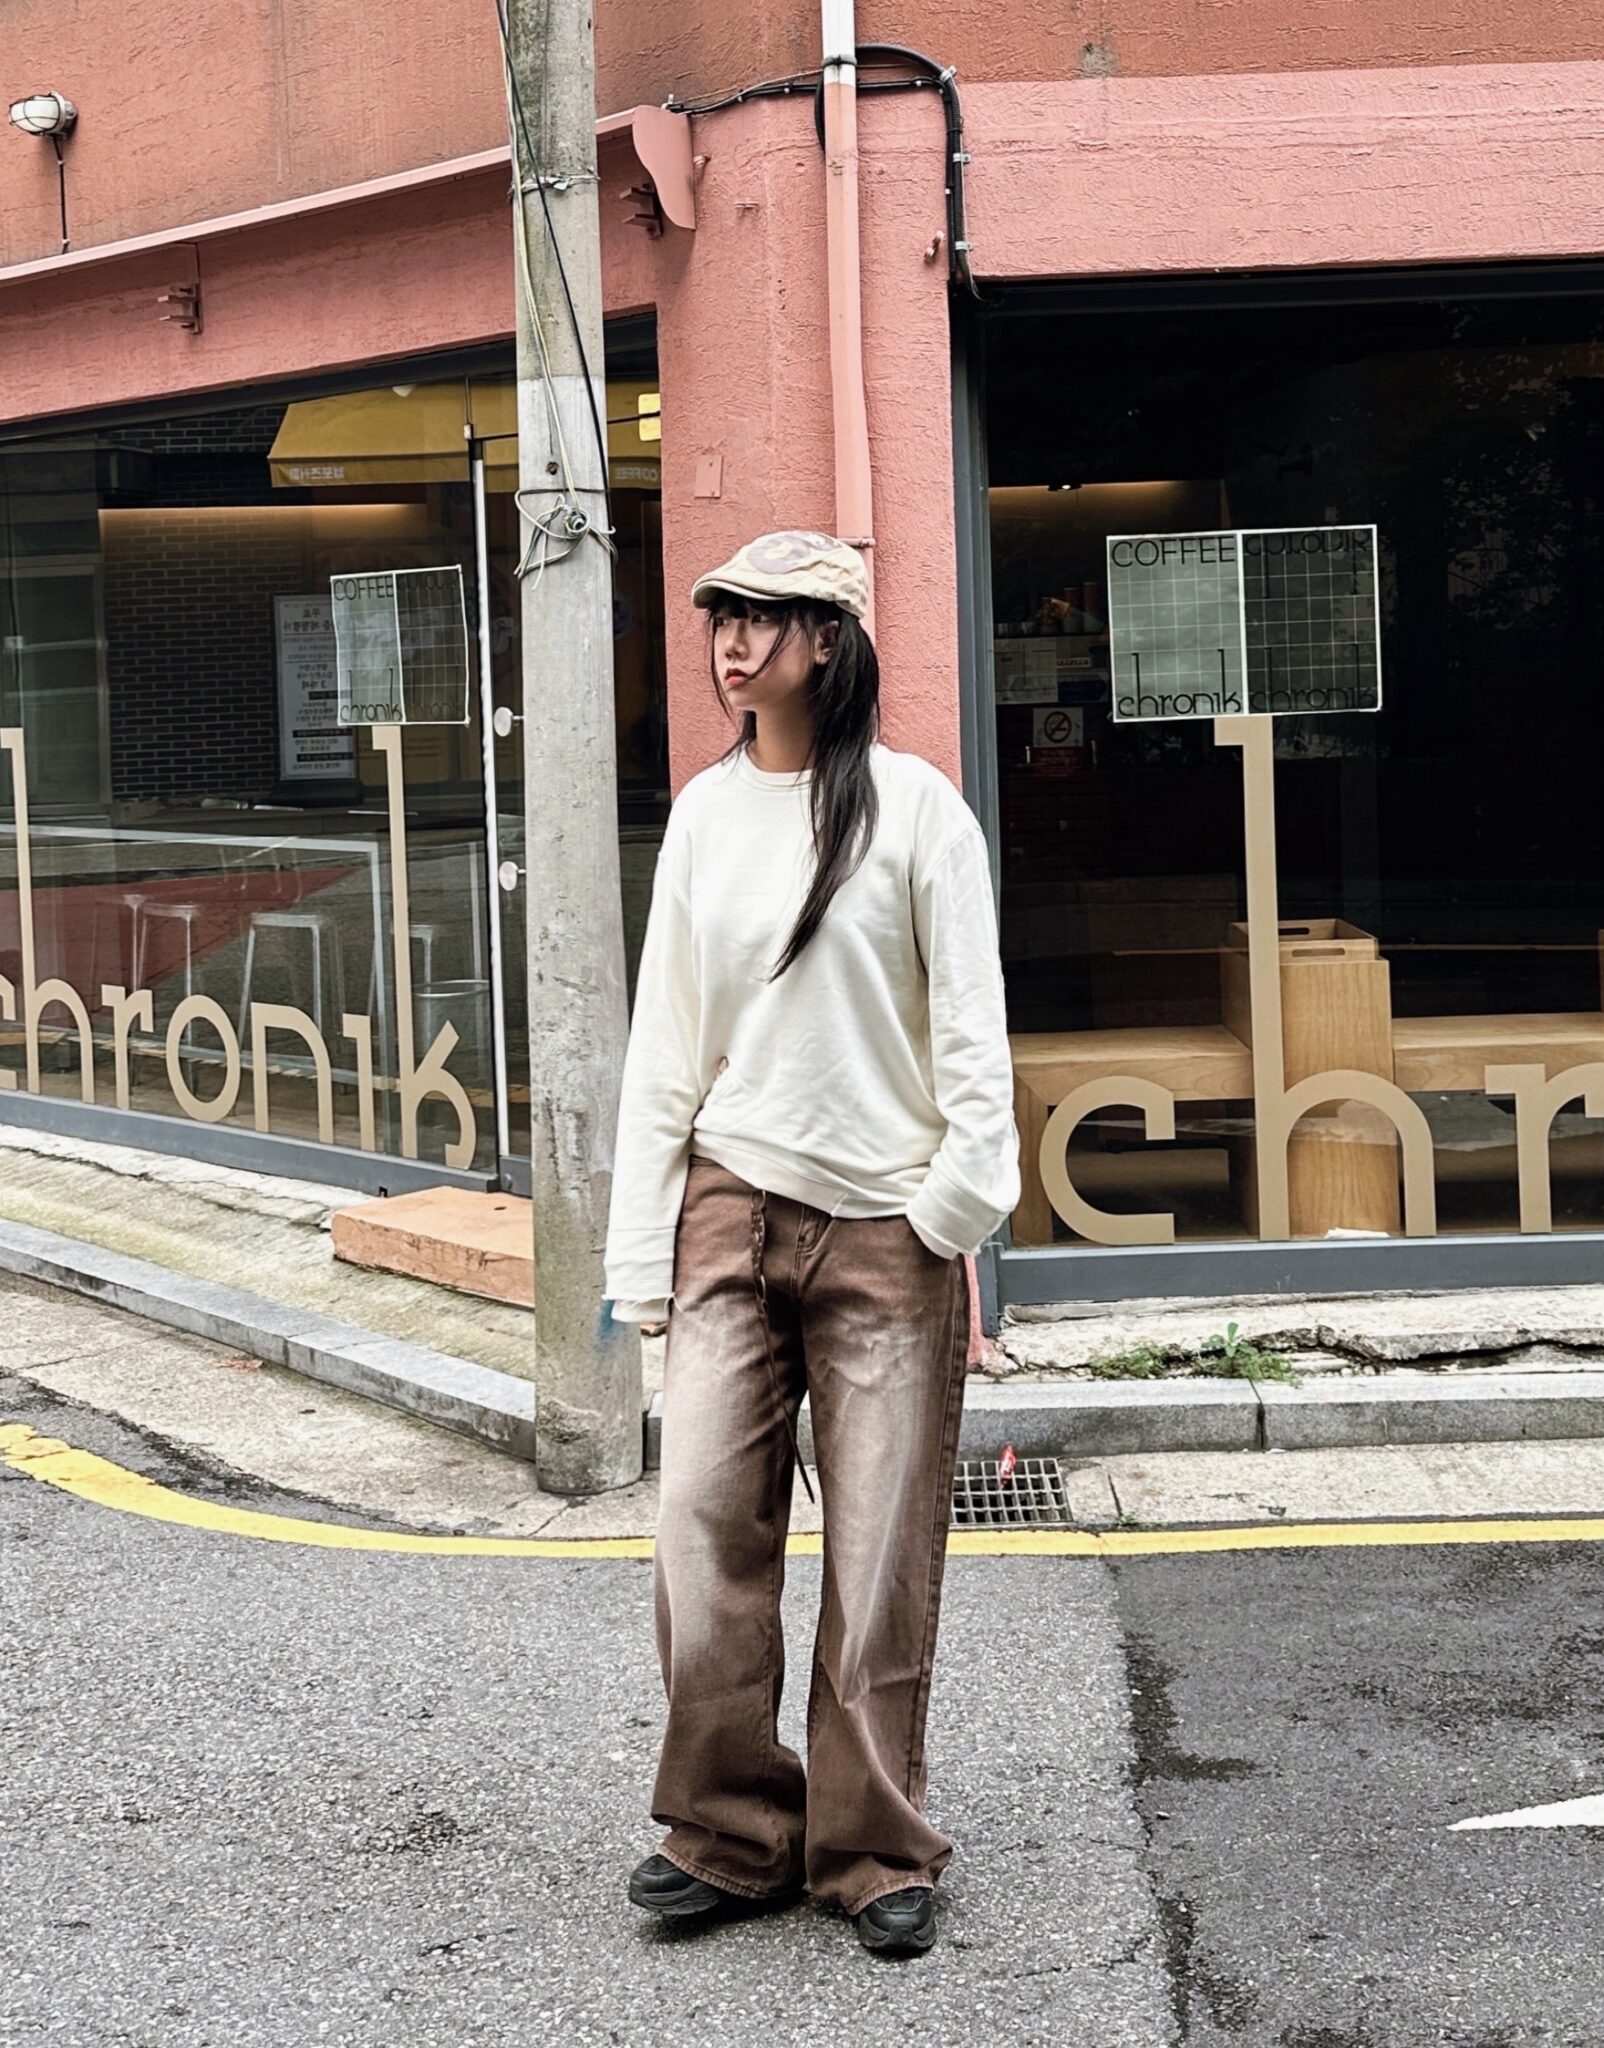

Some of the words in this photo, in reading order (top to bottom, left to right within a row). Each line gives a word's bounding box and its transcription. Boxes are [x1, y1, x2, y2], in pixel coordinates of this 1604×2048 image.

[1111, 535, 1236, 568] COFFEE
[333, 576, 394, 601] COFFEE
[340, 667, 402, 722] chronik
[1117, 648, 1242, 717] chronik
[1250, 643, 1376, 712] chronik
[0, 728, 477, 1170] hronik
